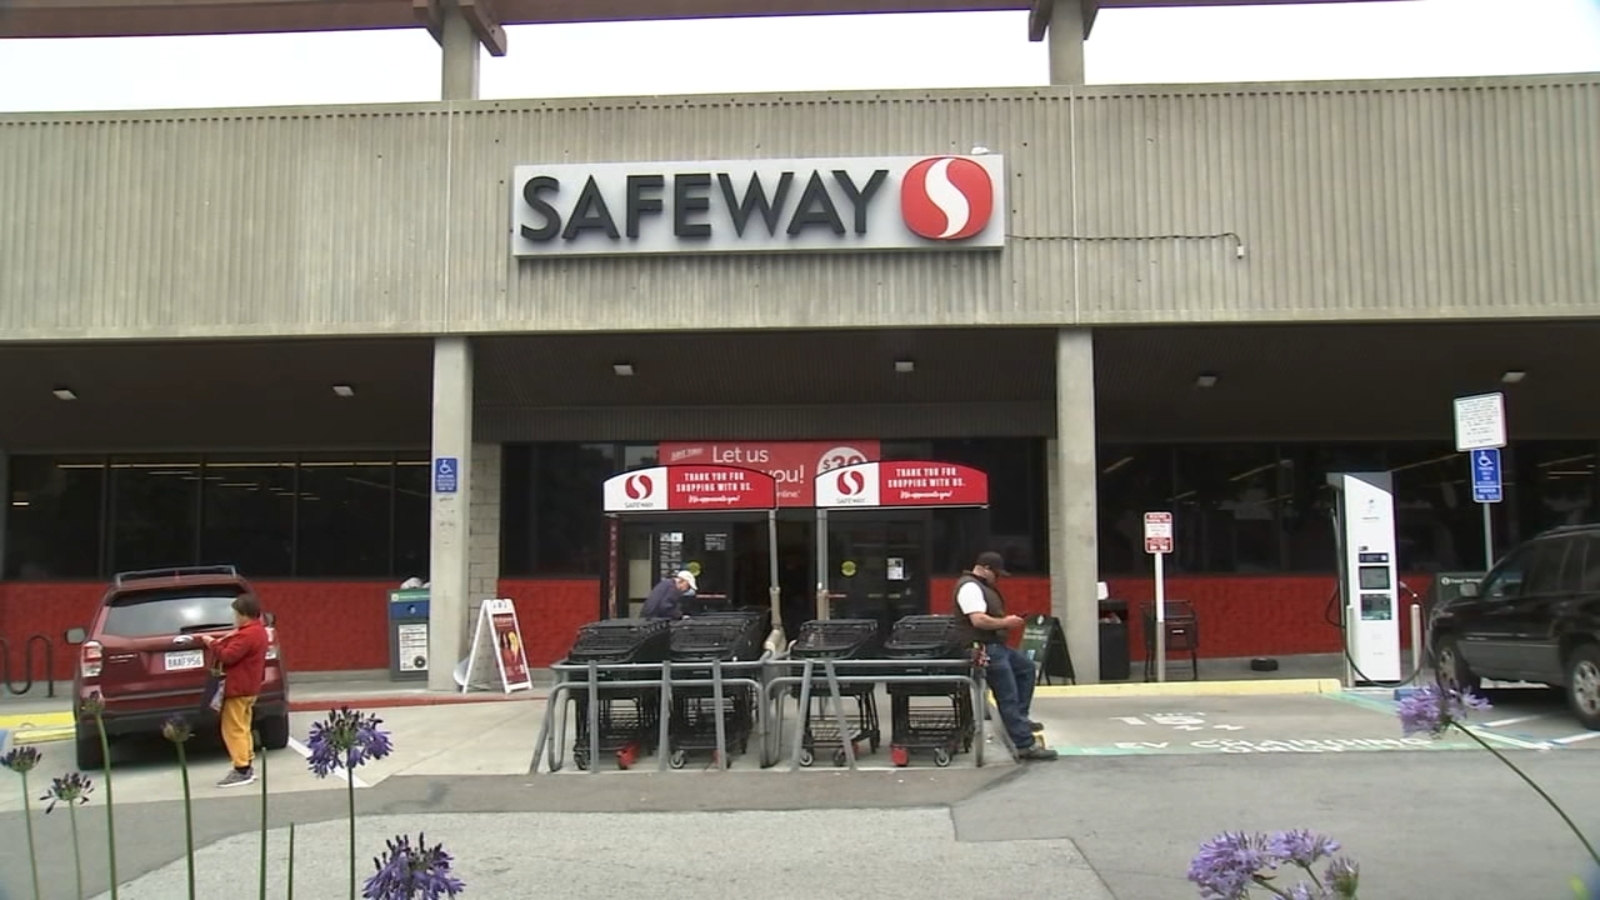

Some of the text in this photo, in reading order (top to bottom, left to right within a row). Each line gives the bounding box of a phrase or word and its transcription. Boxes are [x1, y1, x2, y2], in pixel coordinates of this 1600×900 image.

[520, 169, 889, 242] SAFEWAY
[713, 446, 769, 463] Let us
[684, 472, 744, 481] THANK YOU FOR
[761, 464, 804, 484] ou!
[896, 467, 956, 477] THANK YOU FOR
[676, 483, 715, 492] SHOPPING
[717, 483, 737, 491] WITH
[888, 479, 927, 488] SHOPPING
[929, 478, 950, 487] WITH
